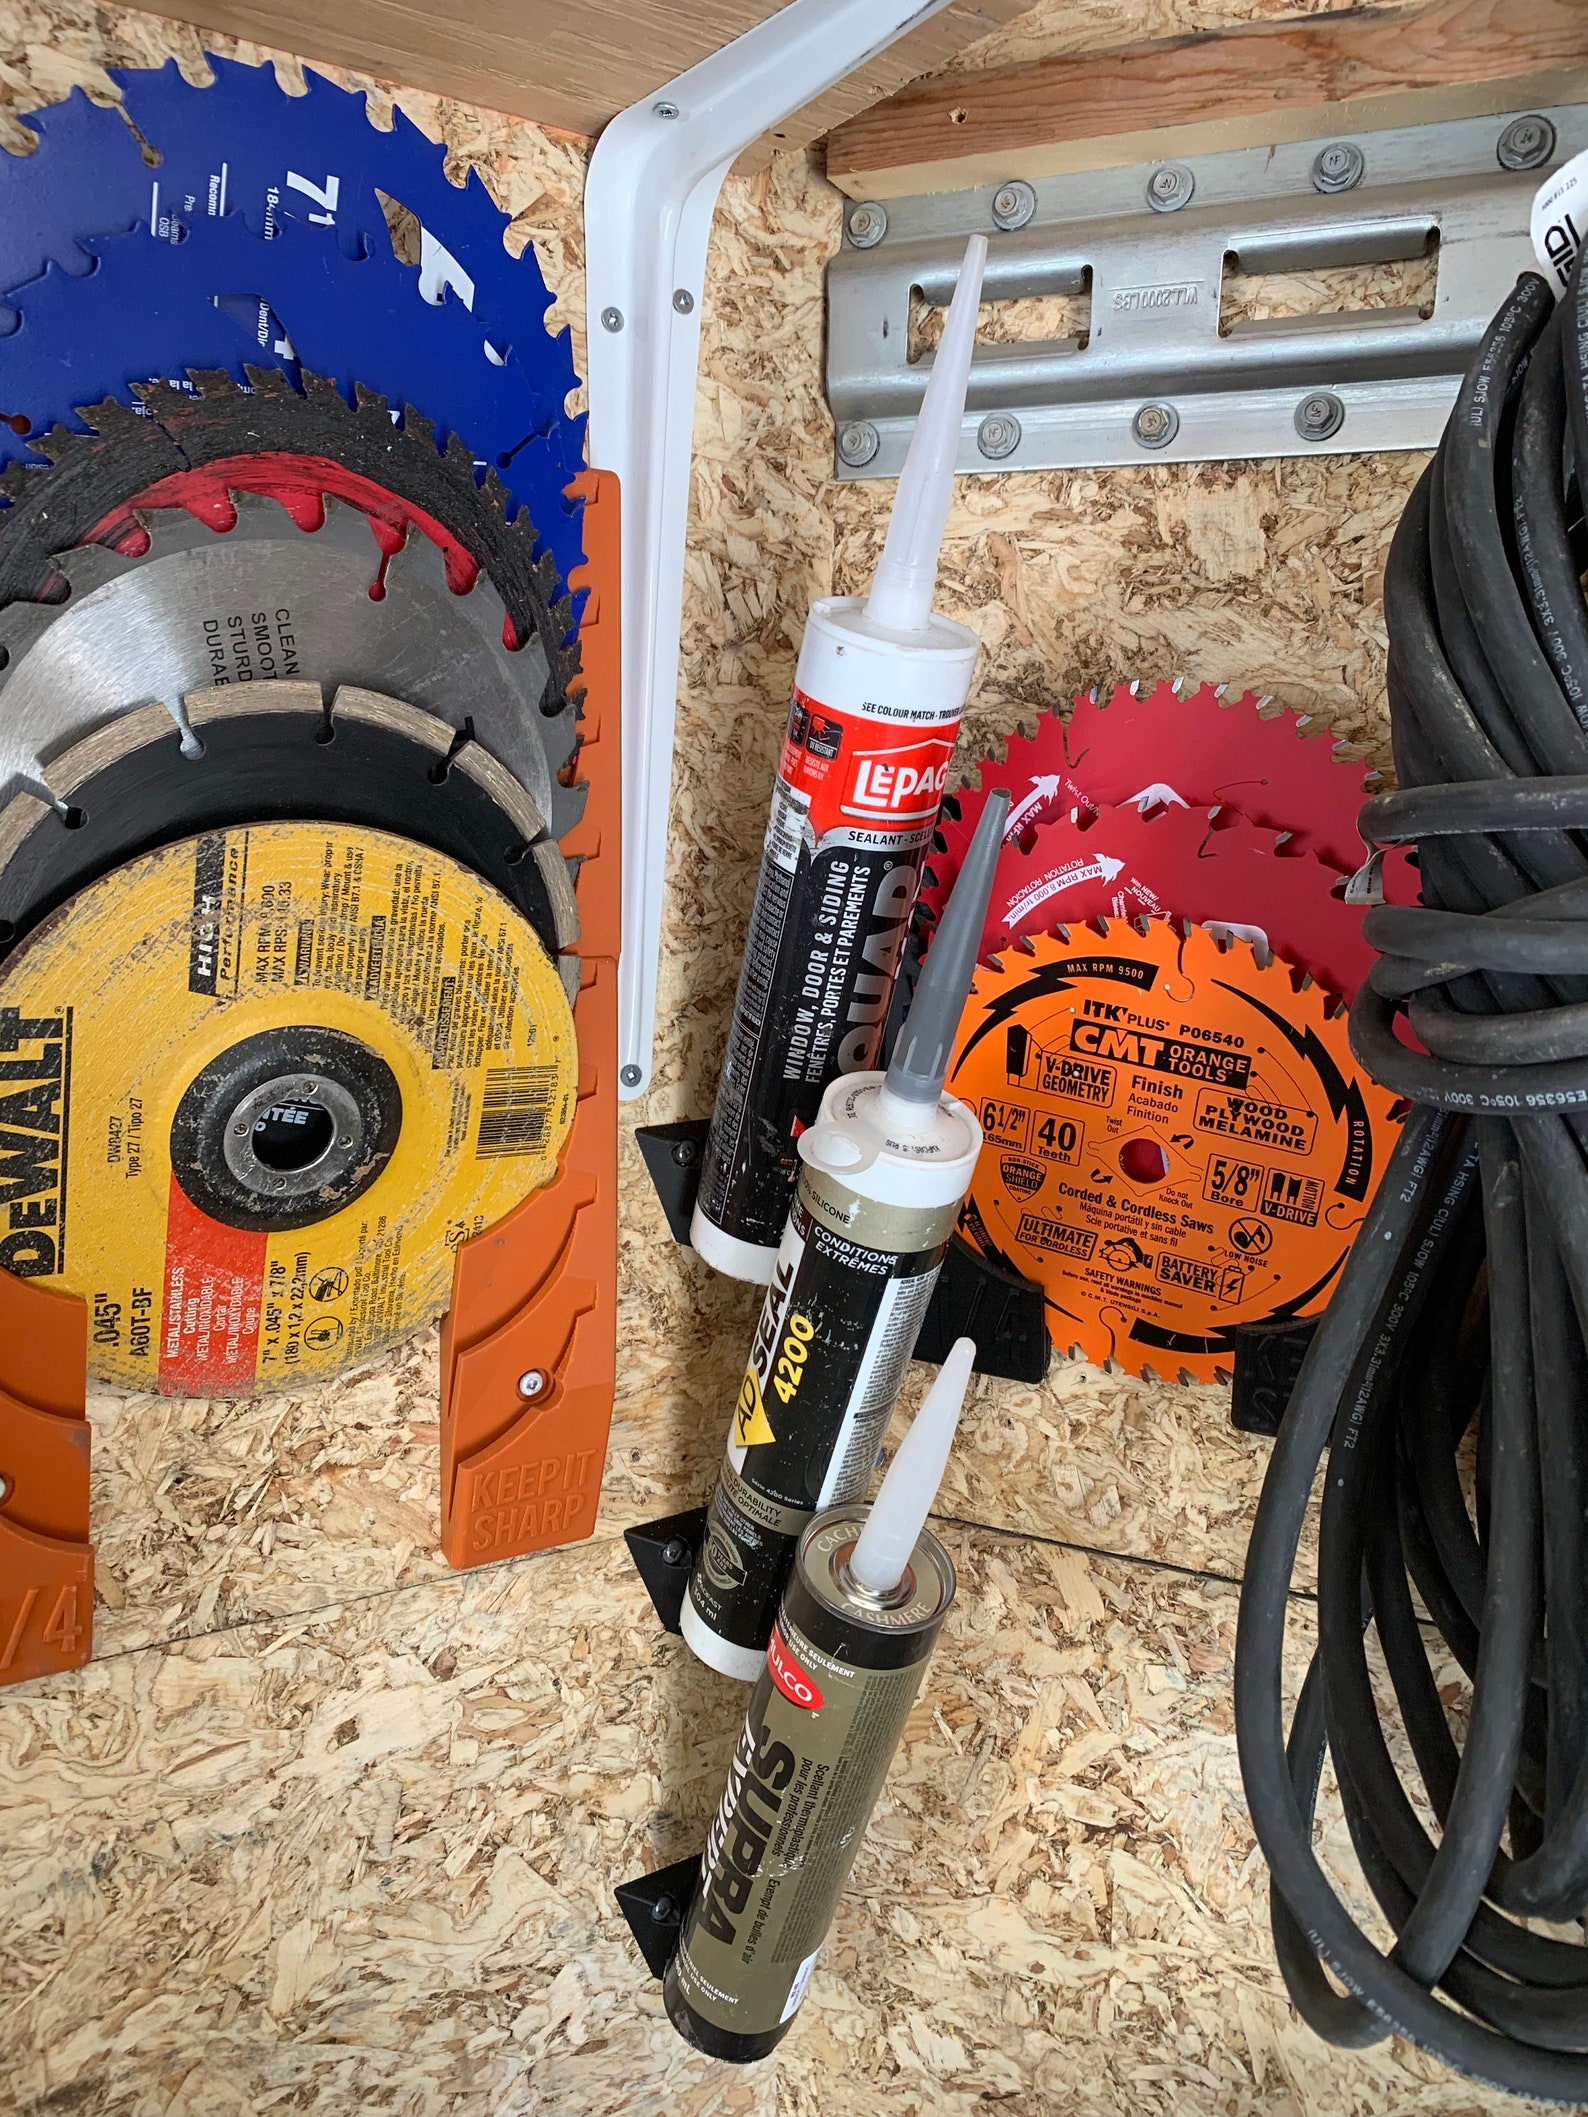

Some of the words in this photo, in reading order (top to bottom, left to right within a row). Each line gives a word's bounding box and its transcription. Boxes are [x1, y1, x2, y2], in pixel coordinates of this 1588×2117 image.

[158, 216, 169, 237] OSB
[275, 608, 299, 674] CLEAN
[861, 701, 876, 713] SEE
[877, 705, 909, 718] COLOUR
[910, 709, 935, 720] MATCH
[814, 742, 833, 757] RESISTANT
[848, 832, 903, 844] SEALANT
[1042, 857, 1084, 880] ROTATION
[1055, 872, 1078, 887] RPM
[1079, 863, 1103, 878] MAX
[817, 859, 850, 926] SIDING
[836, 864, 871, 946] PAREMENTS
[1006, 876, 1041, 908] ROTACIÓN
[1032, 882, 1057, 901] 8,000
[1130, 886, 1160, 911] NOUVEAU
[814, 929, 834, 945] &
[254, 955, 269, 983] MAX
[271, 955, 285, 982] MAX
[832, 945, 851, 966] ET
[837, 865, 921, 1073] QUAD
[800, 948, 829, 999] DOOR
[1066, 963, 1088, 972] MAX
[1092, 963, 1113, 973] RPM
[1118, 965, 1143, 979] 9500
[820, 965, 847, 1017] PORTES
[781, 1001, 819, 1081] WINDOW,
[1072, 1021, 1164, 1067] CMT
[1126, 1013, 1165, 1031] PLUS
[1180, 1024, 1245, 1049] P06540
[801, 1015, 836, 1084] FENÊTRES,
[1169, 1044, 1249, 1075] ORANGE
[1044, 1056, 1111, 1086] V-DRIVE
[1169, 1058, 1228, 1083] TOOLS
[1041, 1073, 1109, 1103] GEOMETRY
[1131, 1074, 1184, 1099] Finish
[129, 1097, 143, 1109] 27
[1126, 1105, 1169, 1124] Finition
[1128, 1092, 1178, 1113] Acabado
[1225, 1096, 1288, 1120] WOOD
[128, 1112, 143, 1130] Tipo
[1036, 1116, 1077, 1152] 40
[1105, 1115, 1122, 1126] Twist
[1106, 1124, 1119, 1134] Out
[1198, 1115, 1306, 1150] MELAMINE
[1204, 1104, 1304, 1137] PLYWOOD
[0, 1007, 63, 1278] DEWALT
[127, 1141, 140, 1153] 27
[1036, 1145, 1071, 1162] Teeth
[1344, 1120, 1364, 1184] ROTATION
[125, 1156, 141, 1179] Type
[1002, 1164, 1042, 1181] ORANGE
[1004, 1173, 1038, 1188] SHIELD
[1008, 1185, 1031, 1195] COATING
[1158, 1193, 1179, 1206] Knock
[1180, 1199, 1193, 1210] Out
[1165, 1187, 1176, 1196] Do
[1177, 1191, 1188, 1200] not
[1210, 1190, 1244, 1207] Bore
[1301, 1179, 1319, 1209] HOLLOW
[1399, 1179, 1417, 1202] FT2
[1443, 1170, 1467, 1206] HSING
[811, 1190, 850, 1224] SILICONE
[1058, 1181, 1103, 1204] Corded
[1105, 1194, 1118, 1208] &
[1120, 1198, 1177, 1224] Cordless
[1179, 1214, 1215, 1234] Saws
[1079, 1201, 1113, 1218] Máquina
[1114, 1210, 1143, 1227] portátil
[1150, 1219, 1163, 1232] sin
[1164, 1223, 1187, 1237] cable
[1262, 1202, 1315, 1225] V-DRIVE
[1019, 1231, 1038, 1243] FOR
[1038, 1235, 1088, 1257] CORDLESS
[1022, 1217, 1093, 1248] ULTIMATE
[1085, 1214, 1103, 1227] Scie
[1103, 1219, 1139, 1238] portative
[1139, 1228, 1148, 1239] et
[1149, 1232, 1168, 1245] sans
[1169, 1235, 1178, 1247] fil
[813, 1226, 899, 1264] CONDITIONS
[814, 1240, 890, 1277] EXTRÊMES
[1224, 1249, 1241, 1260] LOW
[1243, 1255, 1268, 1267] NOISE
[1084, 1267, 1114, 1283] SAFETY
[1115, 1275, 1162, 1296] WARNINGS
[1159, 1267, 1216, 1292] SAVER
[1161, 1255, 1218, 1281] BATTERY
[166, 1266, 184, 1358] METAL/STAINLESS
[183, 1297, 198, 1334] Cutting
[1109, 1299, 1139, 1312] UTENSILI
[1384, 1303, 1404, 1330] 300V
[773, 1315, 815, 1404] 4200
[1341, 1427, 1359, 1450] FT2
[732, 1481, 781, 1518] DURABILITY
[738, 1496, 781, 1526] OPTIMALE
[469, 1493, 587, 1551] SHARP
[787, 1639, 800, 1655] USE
[799, 1651, 818, 1671] ONLY
[808, 1650, 854, 1679] SEULEMENT
[800, 1757, 813, 1779] pour
[793, 1778, 806, 1794] les
[808, 1763, 830, 1801] Scellant
[694, 1725, 795, 1945] SUPRA
[771, 1793, 800, 1858] professionnels
[784, 1800, 817, 1869] thermoplastique
[763, 1878, 781, 1909] Exempt
[756, 1909, 767, 1921] de
[750, 1920, 764, 1945] bulles
[698, 1975, 739, 2005] SEULEMENT
[699, 1985, 717, 2002] ONLY
